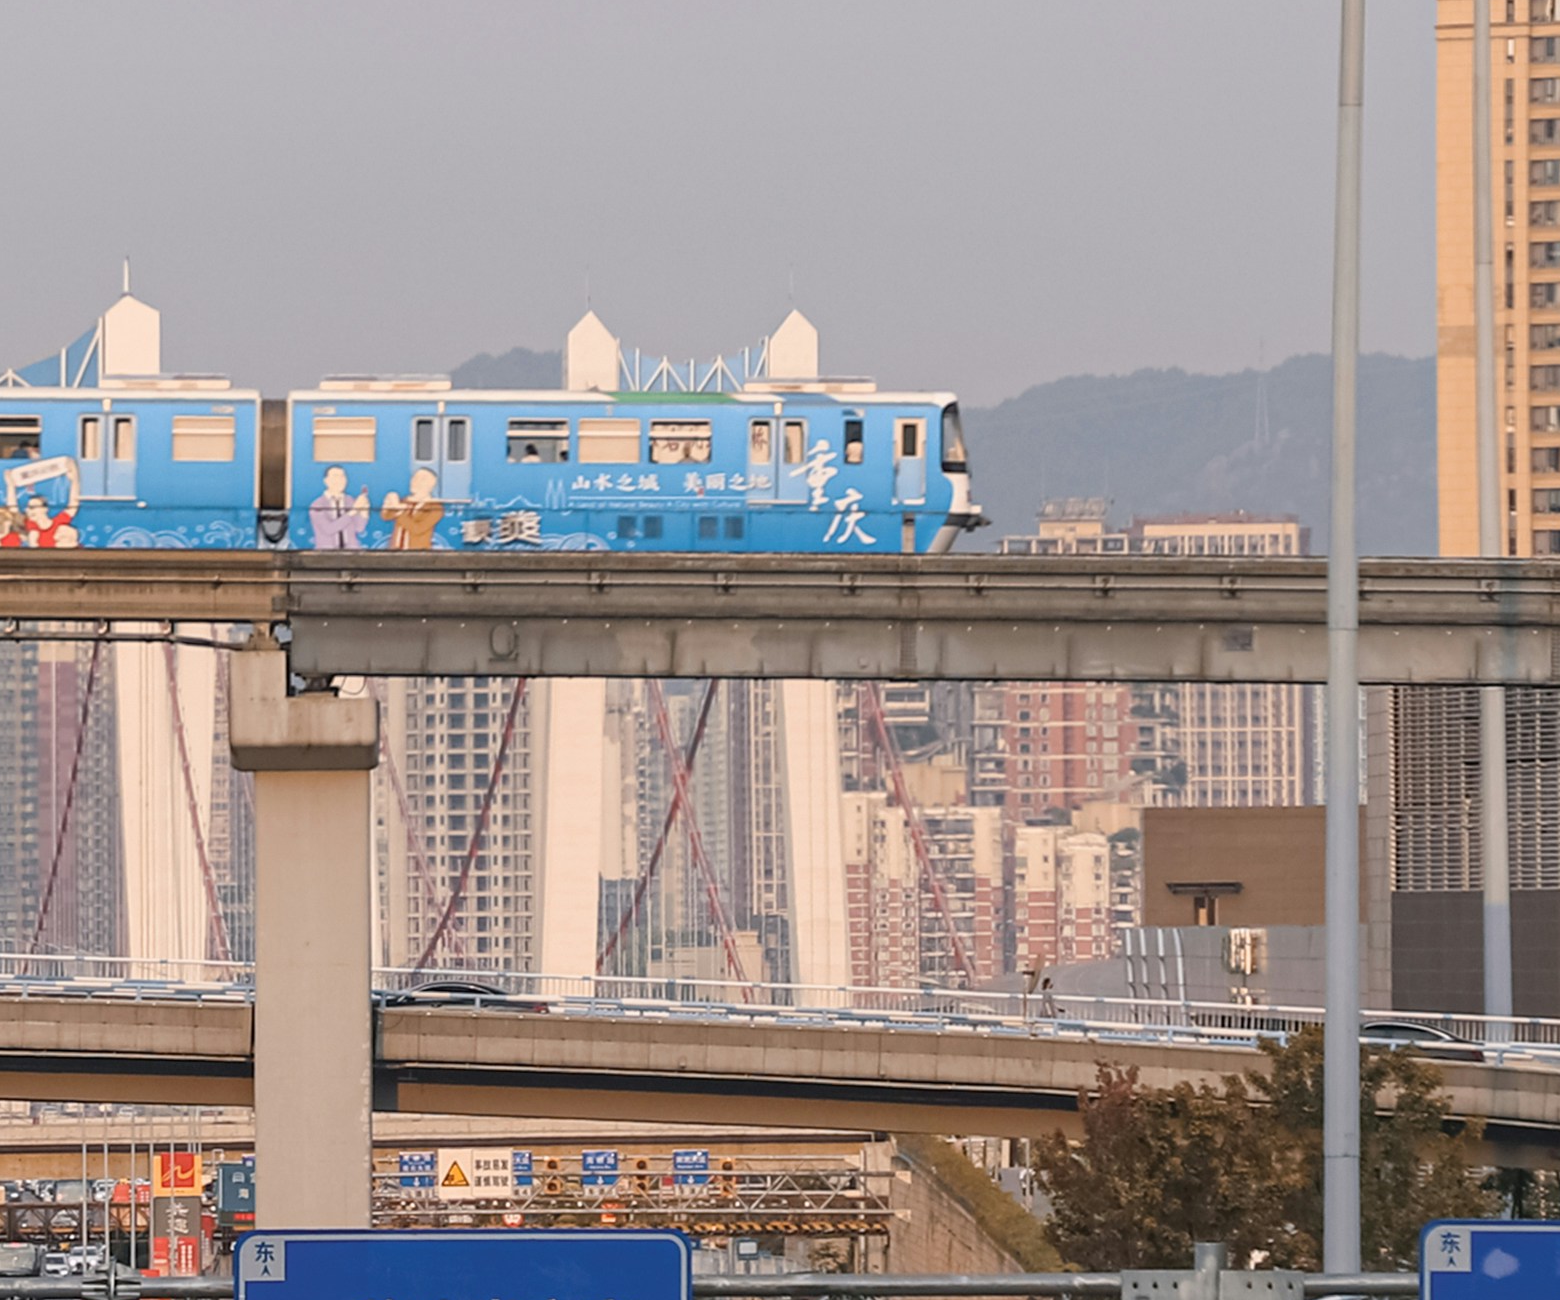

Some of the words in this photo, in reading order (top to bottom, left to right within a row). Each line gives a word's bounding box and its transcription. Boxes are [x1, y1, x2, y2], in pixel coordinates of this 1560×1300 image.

[571, 473, 660, 492] 山水之城
[683, 472, 772, 493] 美丽之地
[788, 438, 876, 545] 重庆
[254, 1242, 275, 1263] 东
[1440, 1232, 1461, 1254] 东
